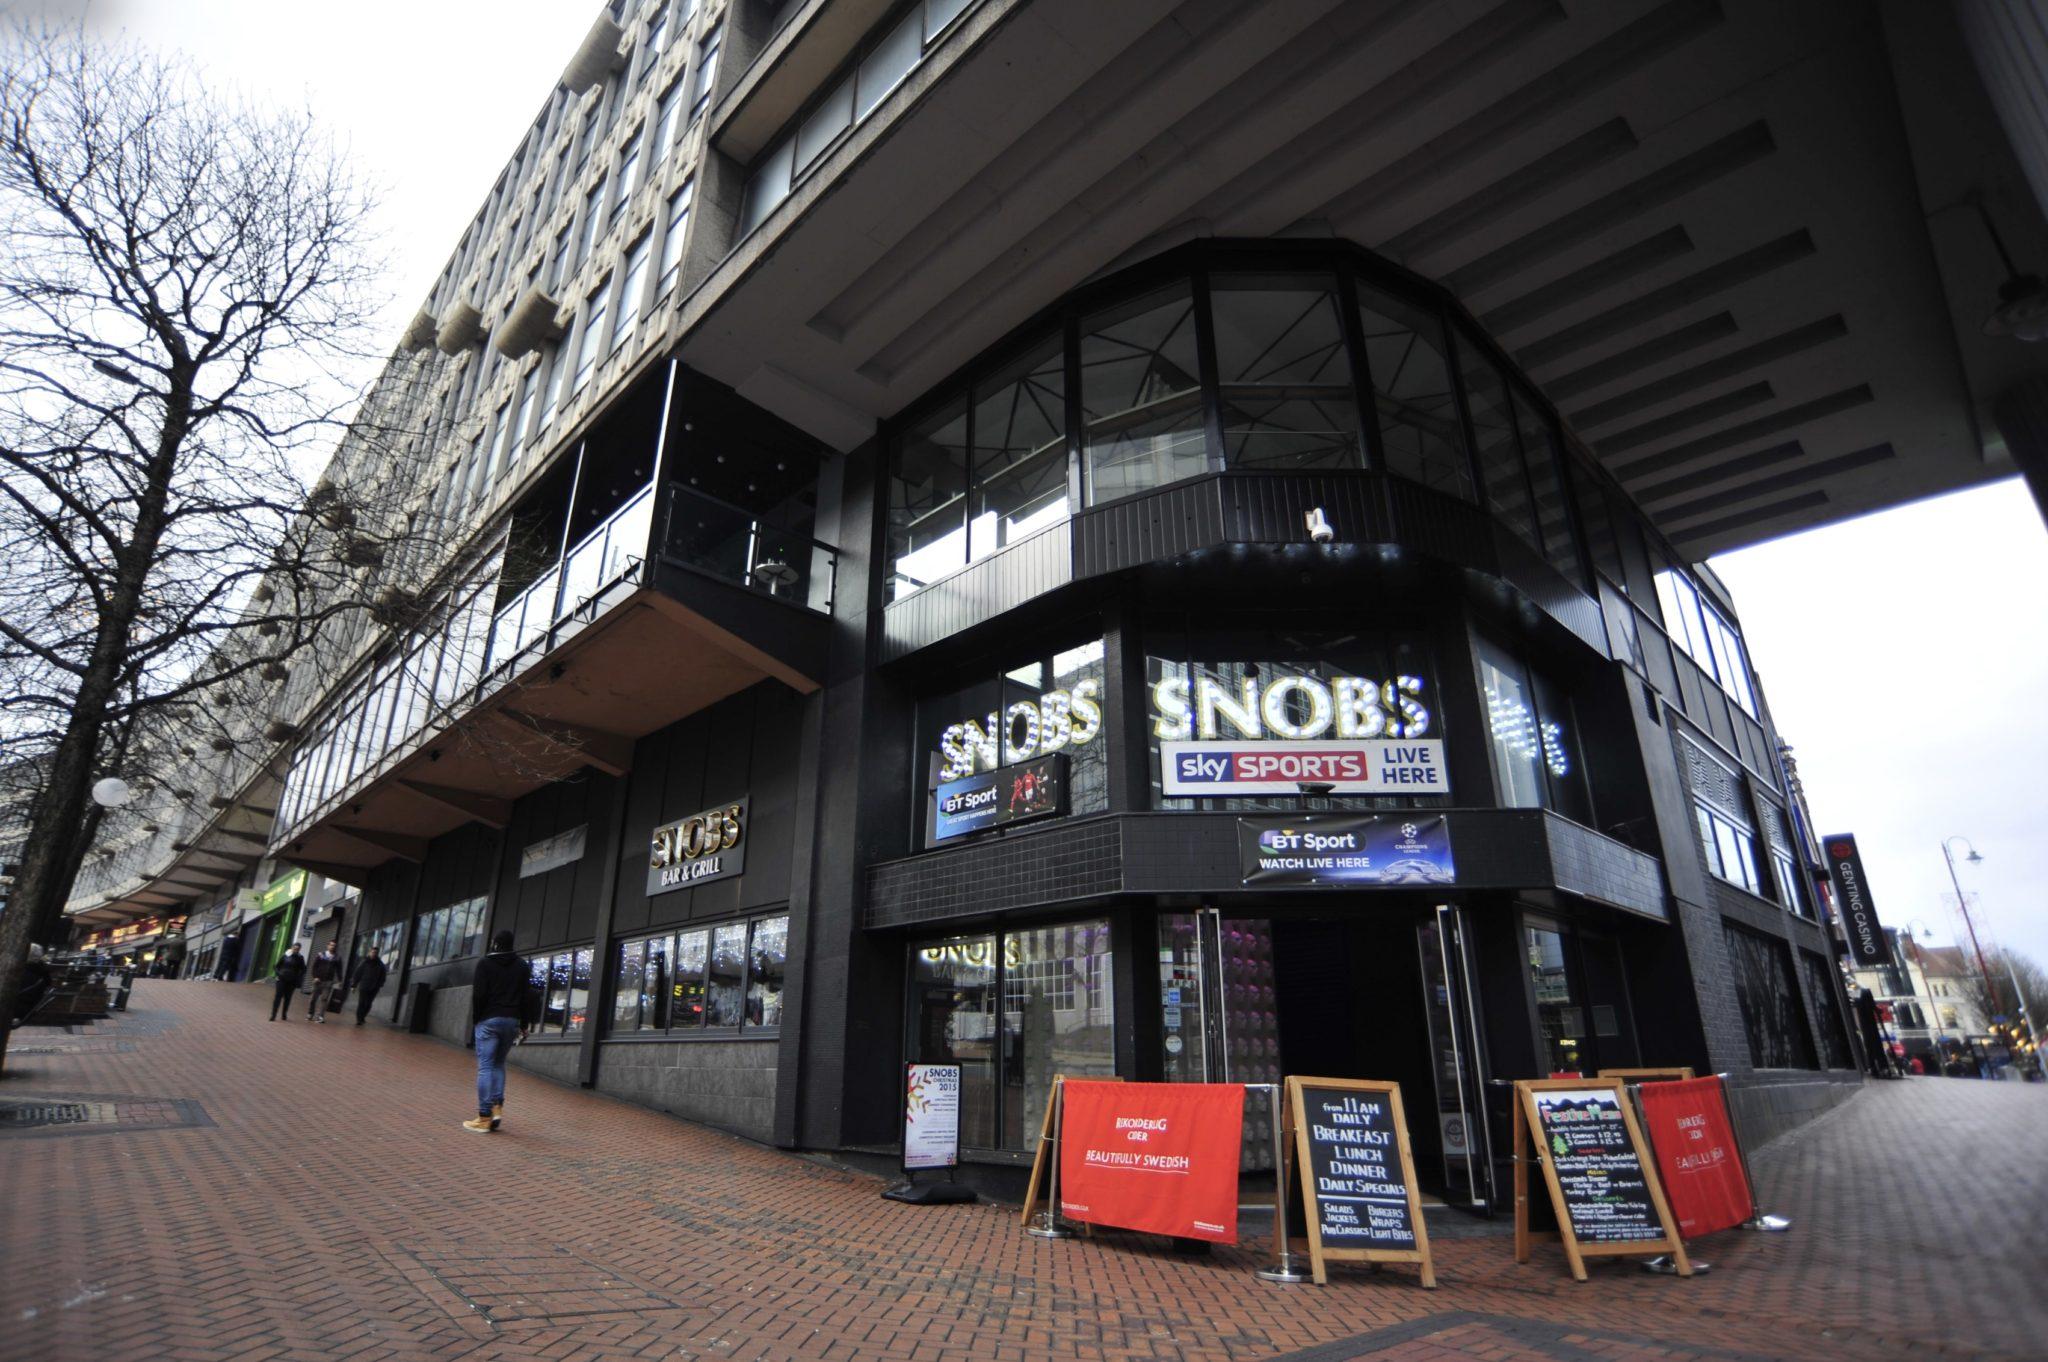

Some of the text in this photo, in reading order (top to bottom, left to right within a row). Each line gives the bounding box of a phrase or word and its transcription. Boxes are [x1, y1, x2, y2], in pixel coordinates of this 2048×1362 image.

[1153, 676, 1430, 740] SNOBS
[940, 679, 1101, 781] SNOBS
[1384, 748, 1431, 764] LIVE
[1181, 754, 1362, 782] sky SPORTS
[1382, 767, 1438, 784] HERE
[946, 785, 997, 812] BT Sport
[651, 804, 740, 869] SNOBS
[1272, 833, 1355, 851] BT Sport
[661, 857, 720, 886] BAR & GRILL
[1259, 857, 1370, 869] WATCH LIVE HERE
[1840, 862, 1876, 955] GENTING CASINO
[929, 1068, 957, 1077] SNOBS
[939, 1083, 957, 1091] 2015
[1322, 1102, 1343, 1111] from
[1332, 1113, 1370, 1125] DAILY
[1313, 1125, 1391, 1145] BREAKFAST
[1086, 1150, 1189, 1168] BEAUTIFULLY SWEDISH
[1334, 1145, 1383, 1162] LUNCH
[1330, 1161, 1388, 1179] DINNER
[1319, 1177, 1408, 1195] DAILY SPECIALS
[1323, 1202, 1354, 1214] SALADS
[1367, 1204, 1405, 1219] BURGERS
[1369, 1216, 1402, 1228] WRAPS
